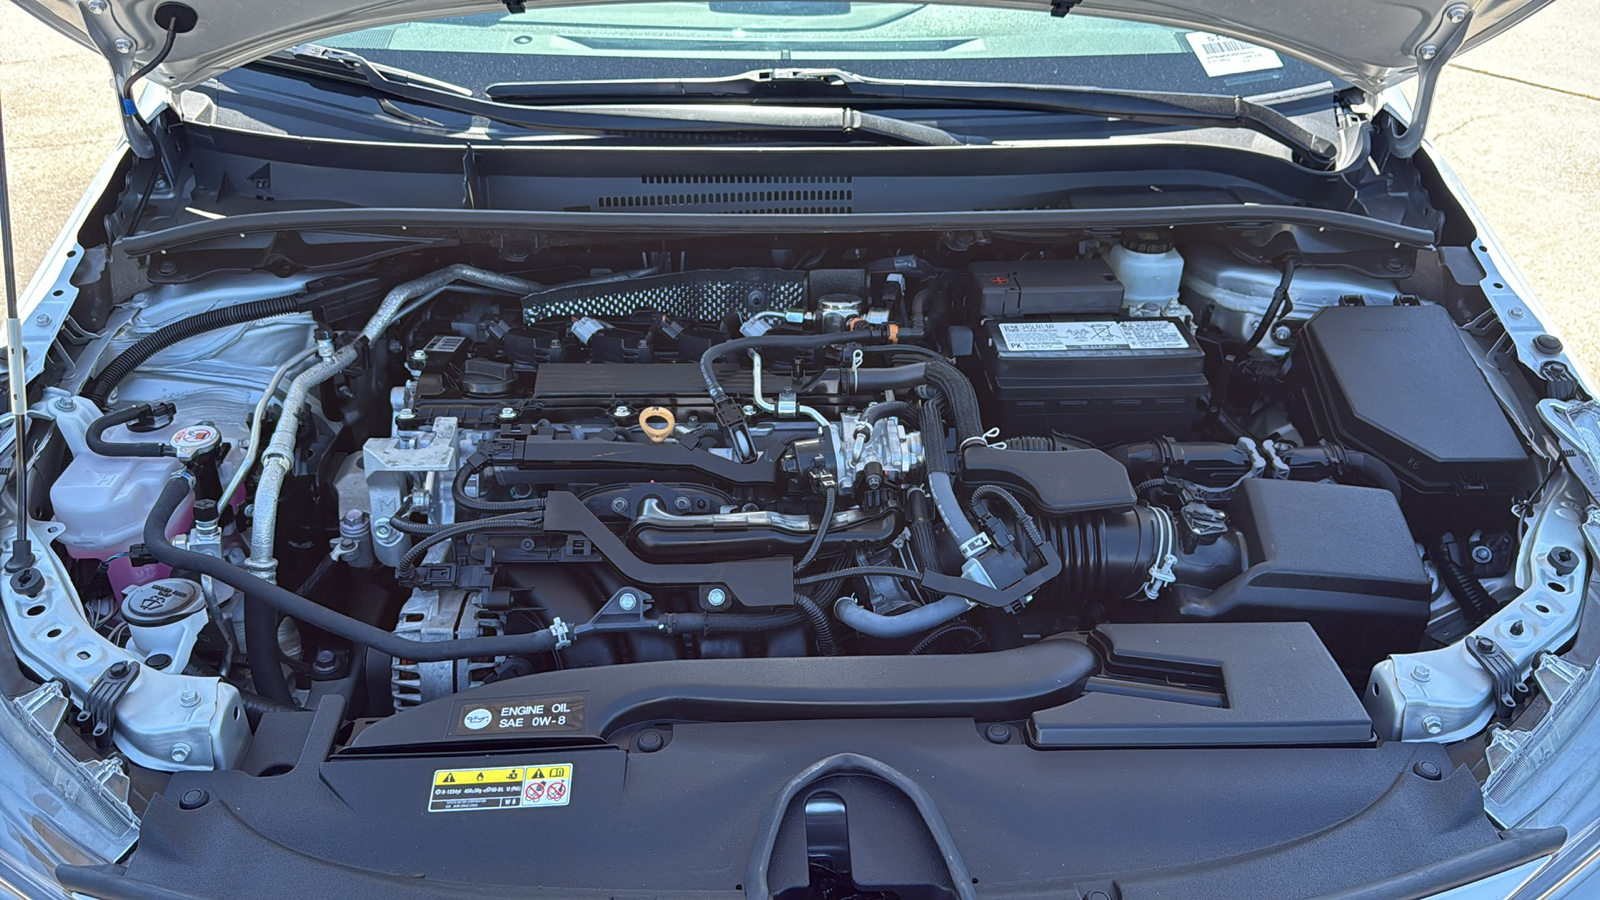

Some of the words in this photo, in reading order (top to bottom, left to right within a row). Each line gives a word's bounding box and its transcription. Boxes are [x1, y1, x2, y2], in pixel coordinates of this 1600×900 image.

[501, 705, 544, 717] ENGINE
[551, 703, 571, 713] OIL
[499, 718, 524, 728] SAE
[532, 715, 566, 727] 0W-8
